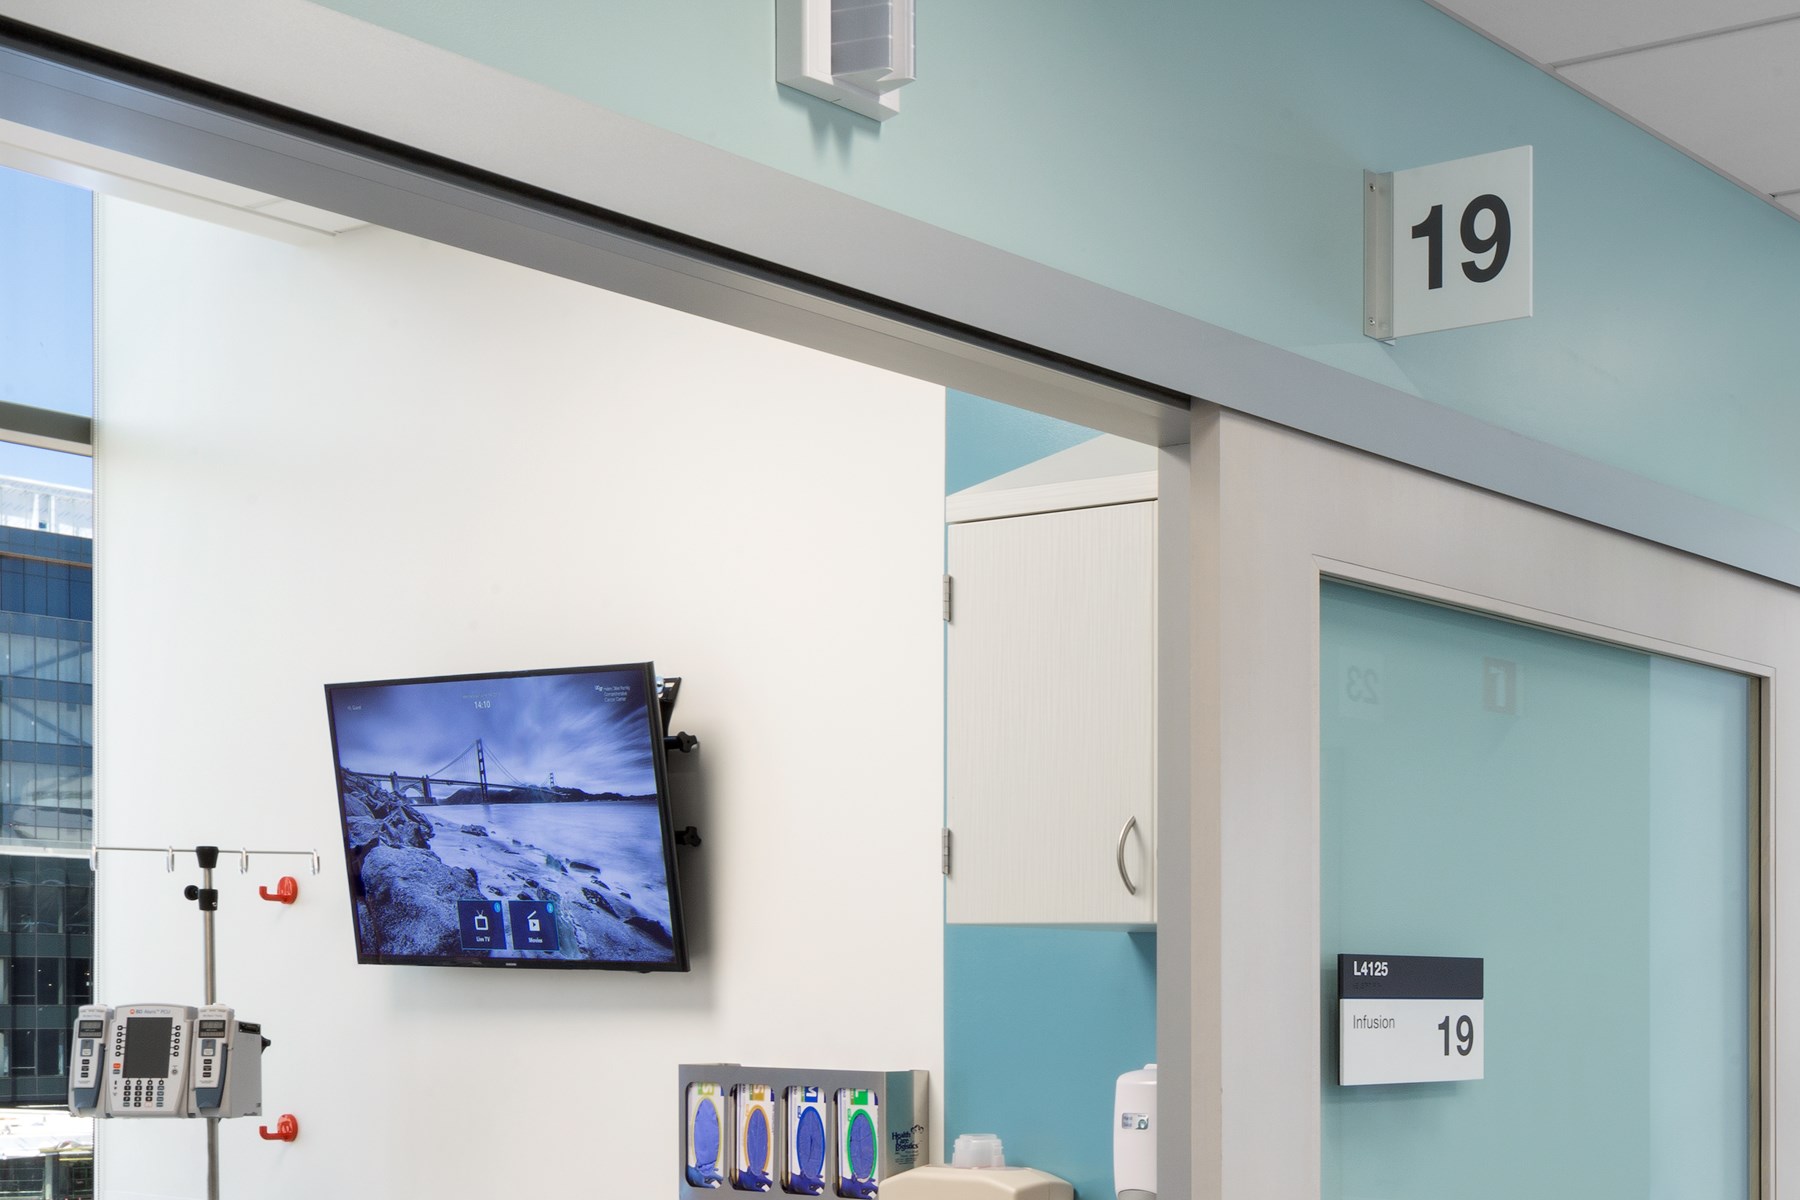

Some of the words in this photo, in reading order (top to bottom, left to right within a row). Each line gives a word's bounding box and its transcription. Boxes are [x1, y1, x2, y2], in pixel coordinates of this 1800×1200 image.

[1411, 193, 1512, 290] 19
[474, 700, 491, 709] 14:10
[1353, 961, 1389, 976] L4125
[1353, 1014, 1396, 1029] Infusion
[1438, 1014, 1474, 1057] 19
[892, 1131, 911, 1140] Health
